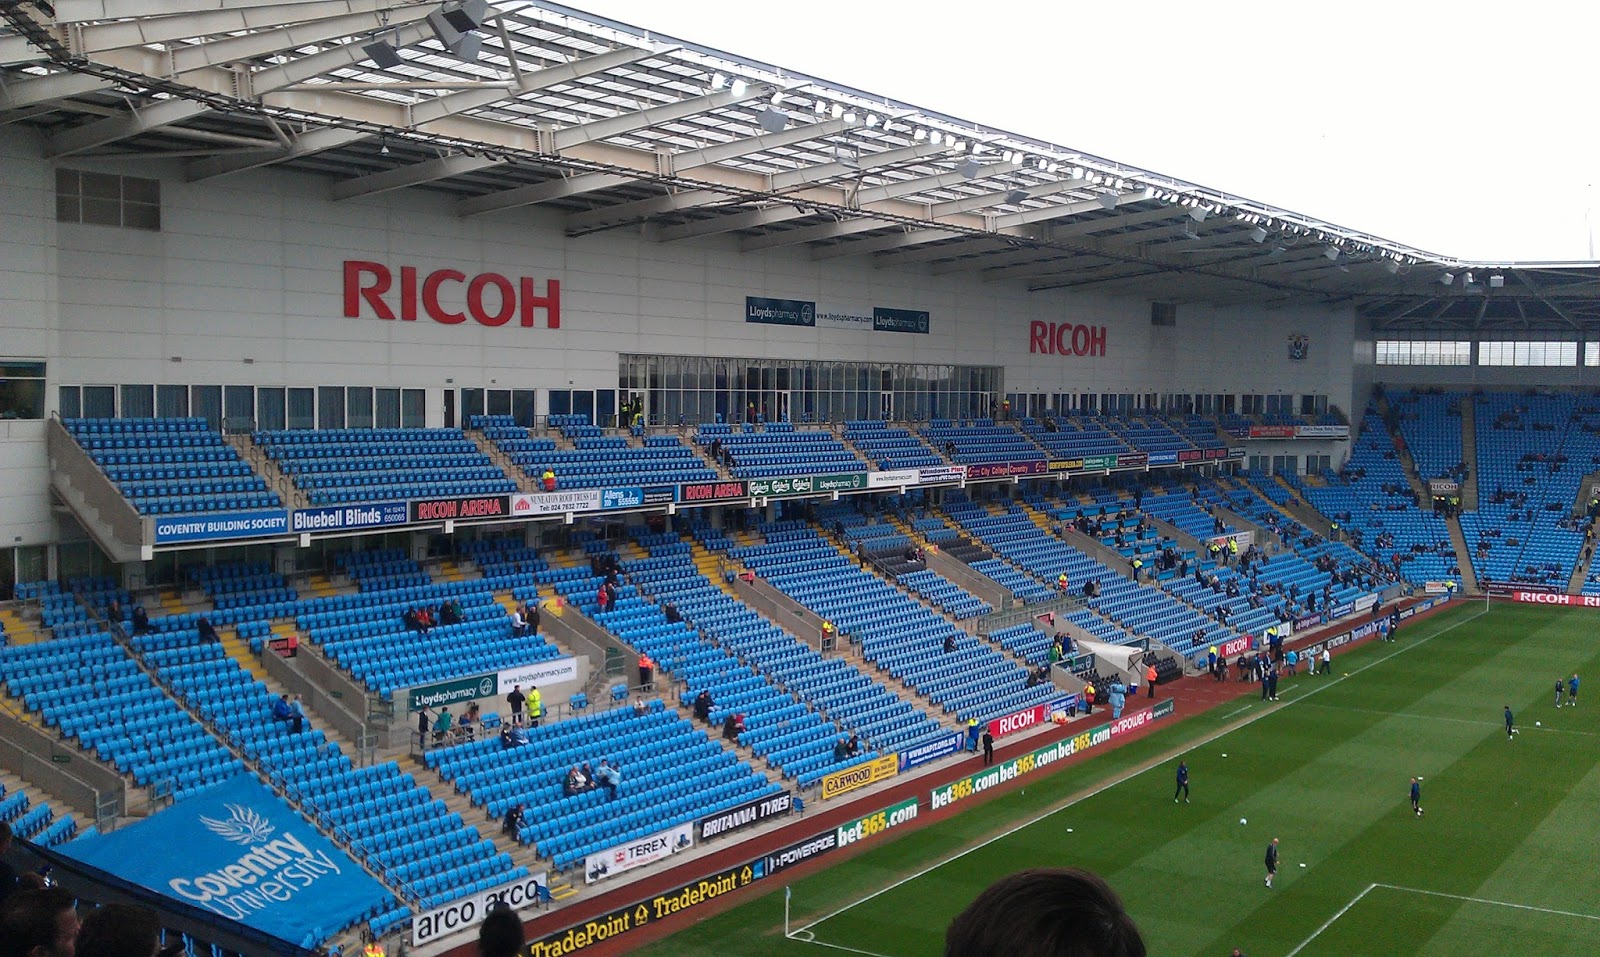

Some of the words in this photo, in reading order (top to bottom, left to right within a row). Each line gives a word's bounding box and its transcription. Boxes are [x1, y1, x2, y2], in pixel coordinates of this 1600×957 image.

[343, 260, 560, 329] RICOH
[749, 305, 800, 322] Lloydspharmacy
[876, 314, 917, 330] Lloydspharmacy
[1030, 320, 1107, 357] RICOH
[920, 467, 950, 476] Windows
[951, 466, 964, 474] Plus
[685, 484, 711, 500] RICOH
[713, 482, 743, 498] ARENA
[294, 510, 343, 530] Bluebell
[346, 507, 381, 525] Blinds
[418, 500, 458, 519] RICOH
[460, 498, 501, 517] ARENA
[157, 521, 206, 536] COVENTRY
[207, 519, 250, 534] BUILDING
[251, 517, 286, 530] SOCIETY
[1520, 592, 1569, 604] RICOH
[1226, 638, 1247, 655] RICOH
[503, 666, 573, 686] www.lloydspharmacy.com
[415, 686, 477, 707] Lloydspharmacy
[1000, 709, 1035, 734] RICOH
[1118, 711, 1147, 733] npower
[908, 736, 956, 760] WWW.NAPIT.ORG.UK
[1057, 726, 1111, 758] bet365.com
[999, 747, 1058, 783] bet365.com
[826, 767, 871, 793] CARWOOD
[931, 772, 999, 809] bet365.com
[702, 807, 757, 838] BRITANNIA
[759, 794, 790, 818] TYRES
[837, 803, 918, 848] bet365.com
[628, 836, 668, 859] TEREX
[780, 834, 835, 867] POWERADE
[168, 832, 314, 901] Coventry
[201, 849, 342, 921] University
[485, 879, 539, 916] arco
[653, 875, 737, 919] TradePoint
[418, 901, 475, 940] arco
[530, 911, 630, 957] TradePoint
